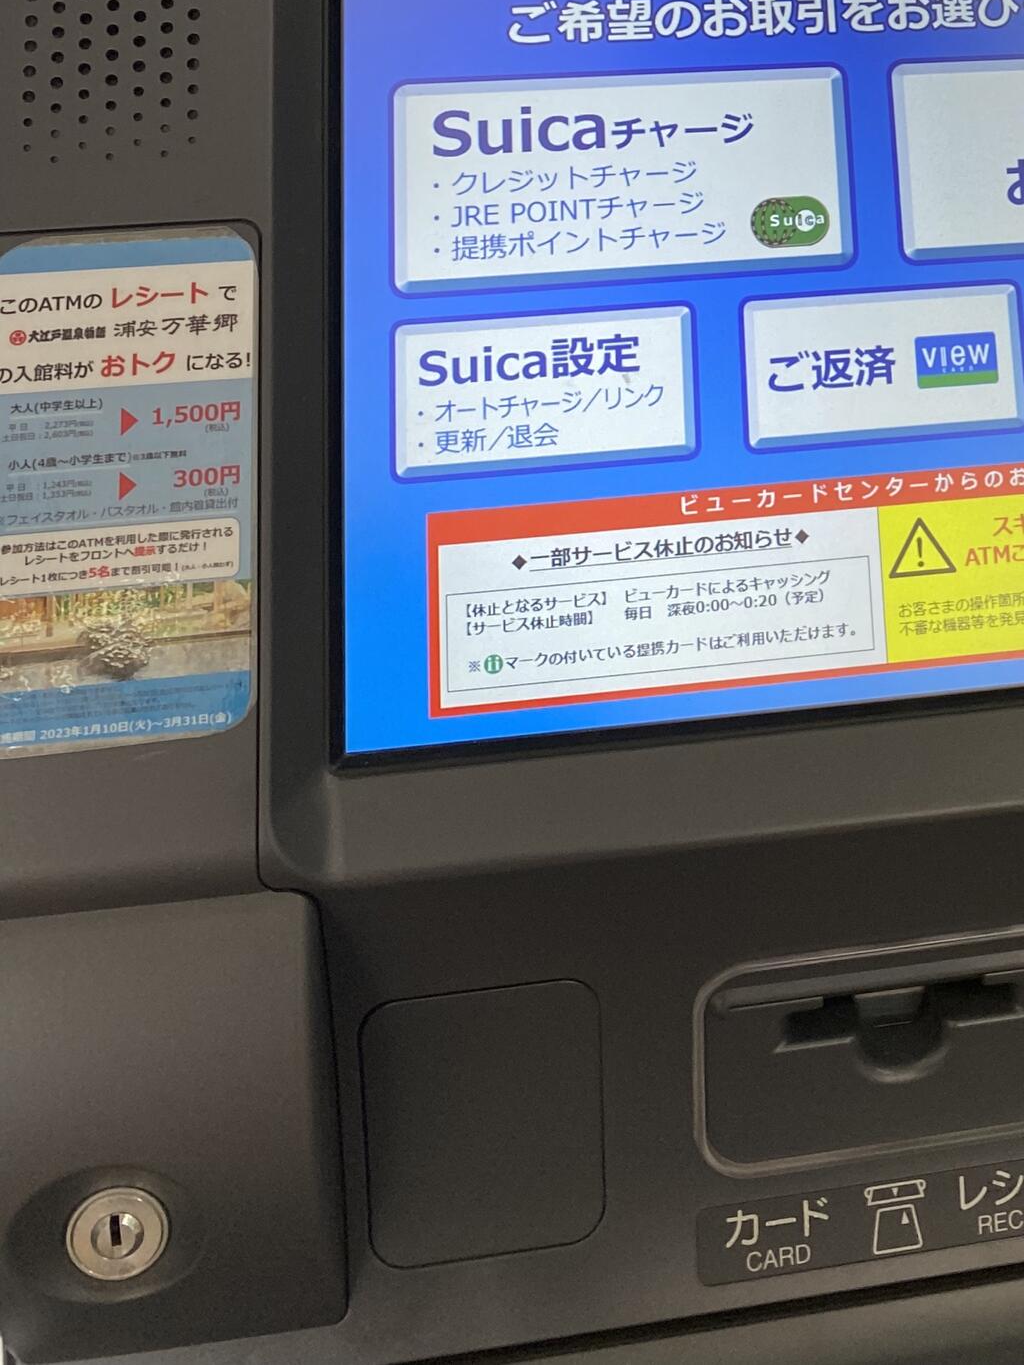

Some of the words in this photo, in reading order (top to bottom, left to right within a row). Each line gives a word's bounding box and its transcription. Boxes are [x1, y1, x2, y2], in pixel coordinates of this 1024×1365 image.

[432, 106, 754, 157] Suicaチャージ
[451, 203, 498, 229] JRE
[511, 191, 704, 225] POINTチャージ
[770, 214, 825, 227] Suica
[1, 292, 103, 315] このATMの
[111, 282, 208, 308] レシート
[219, 285, 237, 301] で
[0, 360, 94, 384] の入館料が
[100, 351, 176, 378] おトク
[418, 334, 640, 386] Suica設定
[768, 345, 895, 394] ご返済
[152, 401, 241, 429] 1,500円
[173, 465, 241, 488] 300円
[465, 590, 608, 619] 【休止となるサービス】
[625, 570, 831, 604] ビューカードによるキャッシング
[466, 611, 595, 637] 【サービス休止時間】
[625, 606, 651, 622] 毎日
[725, 1197, 829, 1248] カード
[746, 1244, 811, 1272] CARD
